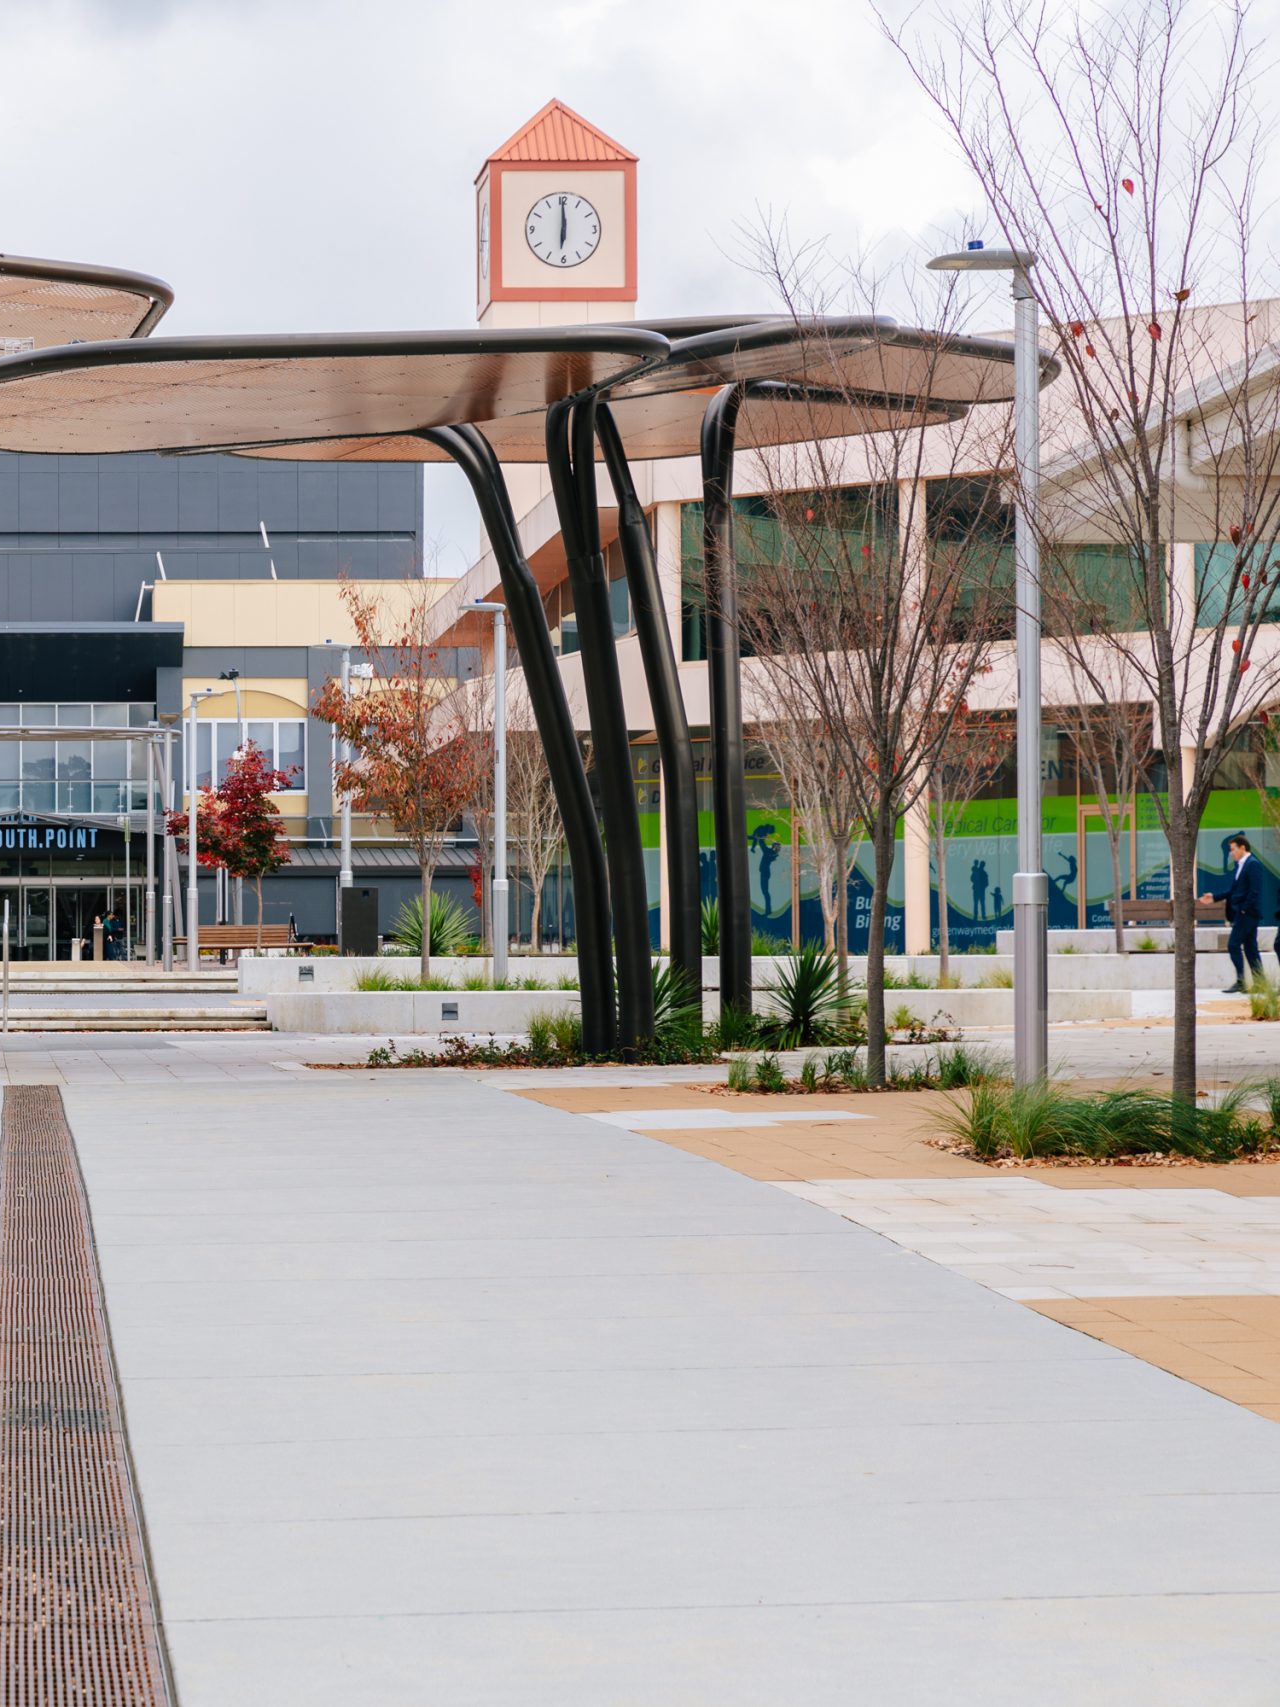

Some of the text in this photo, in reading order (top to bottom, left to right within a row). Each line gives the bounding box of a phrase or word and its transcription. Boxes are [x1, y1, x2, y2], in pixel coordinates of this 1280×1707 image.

[558, 196, 568, 205] 12
[529, 225, 536, 234] 9
[592, 225, 598, 234] 3
[561, 255, 567, 264] 6
[992, 815, 1018, 832] Car
[1041, 816, 1057, 831] or
[975, 838, 1010, 856] Walk
[1043, 836, 1063, 853] ife
[855, 896, 874, 910] Bu
[855, 914, 902, 931] Bing
